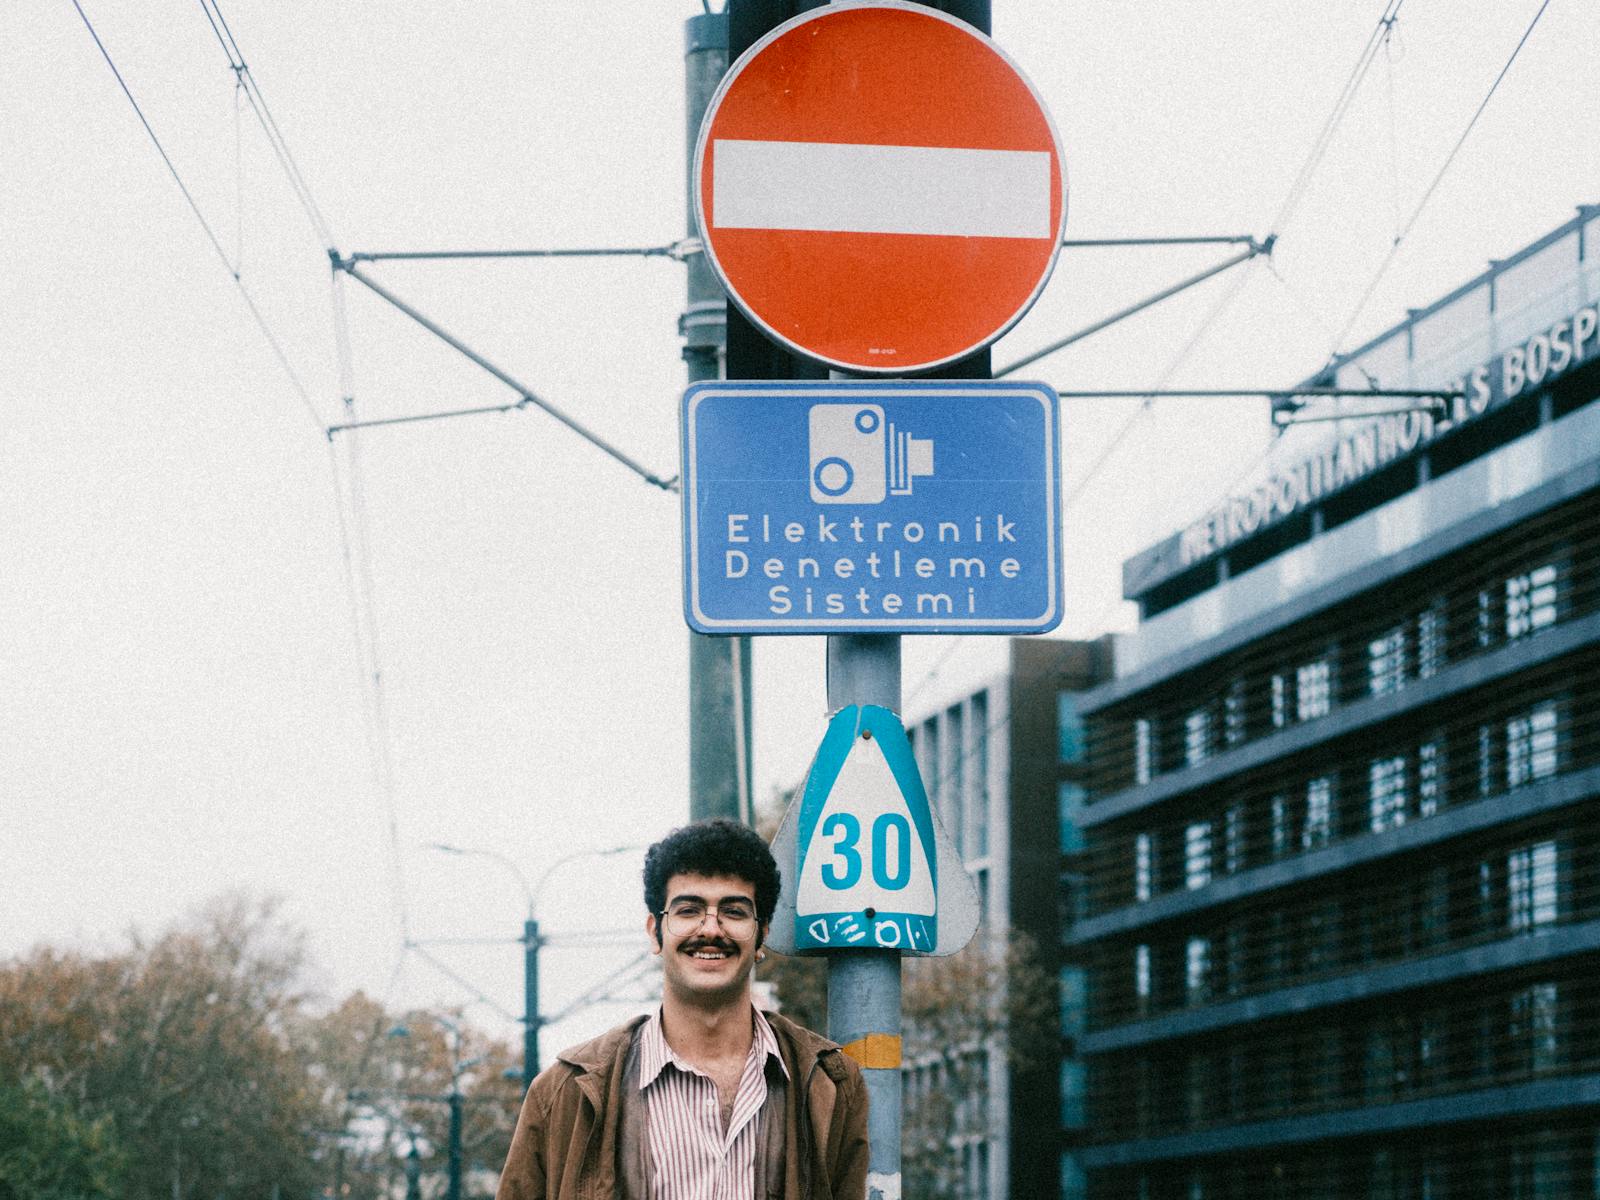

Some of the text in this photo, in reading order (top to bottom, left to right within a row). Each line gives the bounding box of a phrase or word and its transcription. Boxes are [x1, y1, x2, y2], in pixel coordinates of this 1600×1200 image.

[1502, 301, 1600, 398] BOSP
[728, 514, 1016, 543] Elektronik
[726, 550, 1021, 578] Denetleme
[769, 585, 975, 614] Sistemi
[821, 812, 911, 891] 30
